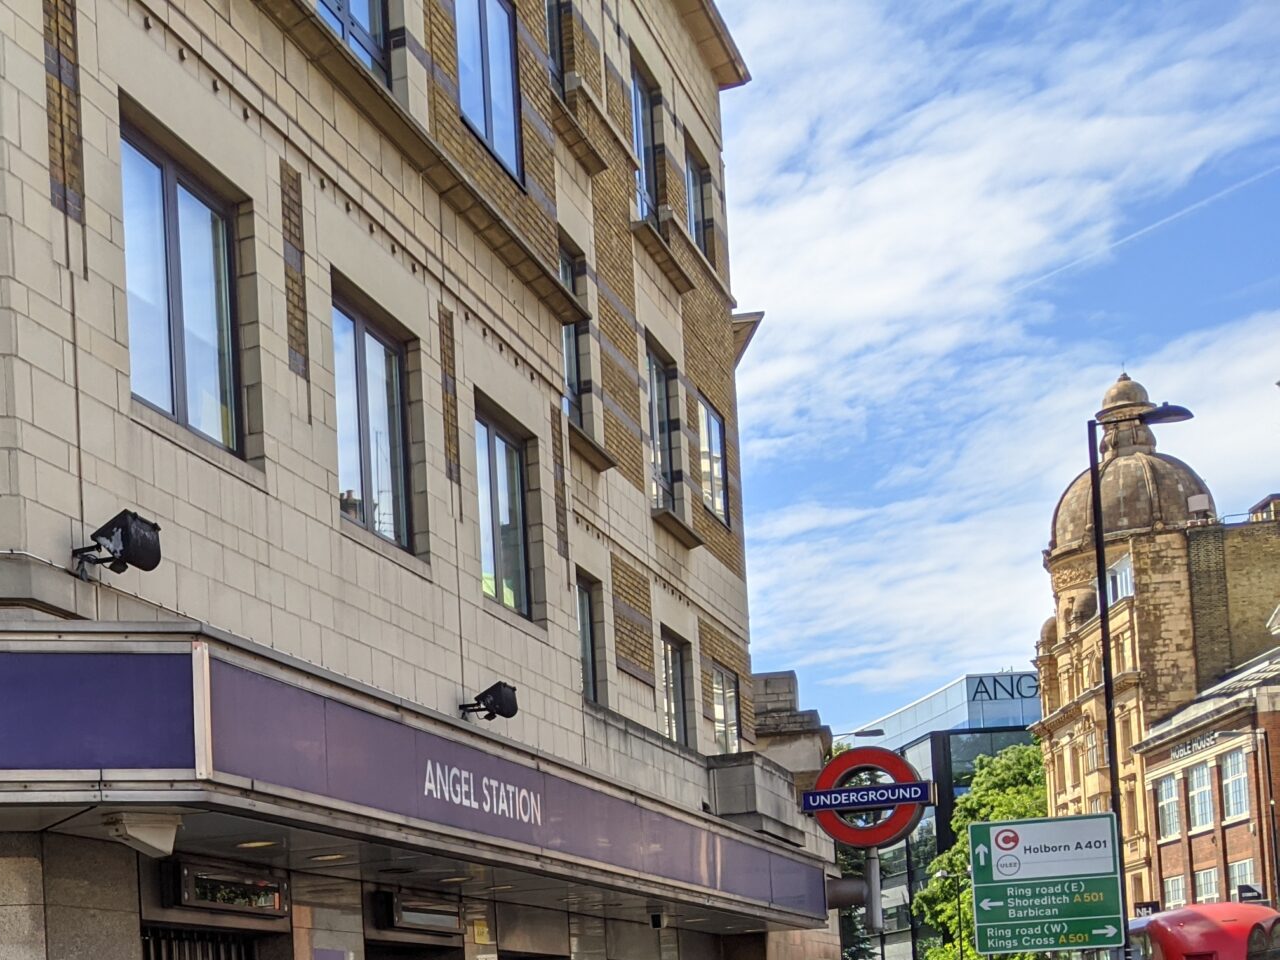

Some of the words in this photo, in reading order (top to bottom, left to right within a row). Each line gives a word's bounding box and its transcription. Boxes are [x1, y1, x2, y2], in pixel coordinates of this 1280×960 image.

[424, 759, 479, 809] ANGEL
[482, 776, 542, 826] STATION
[809, 787, 921, 807] UNDERGROUND
[1023, 843, 1071, 854] Holborn
[1007, 887, 1032, 896] Ring
[1036, 883, 1061, 894] road
[1064, 881, 1085, 892] (E)
[1007, 895, 1070, 907] Shoreditch
[1008, 907, 1059, 918] Barbican
[987, 927, 1012, 938] Ring
[1015, 924, 1041, 936] road
[1044, 923, 1068, 934] (W)
[987, 938, 1018, 949] Kings
[1022, 936, 1055, 946] Cross
